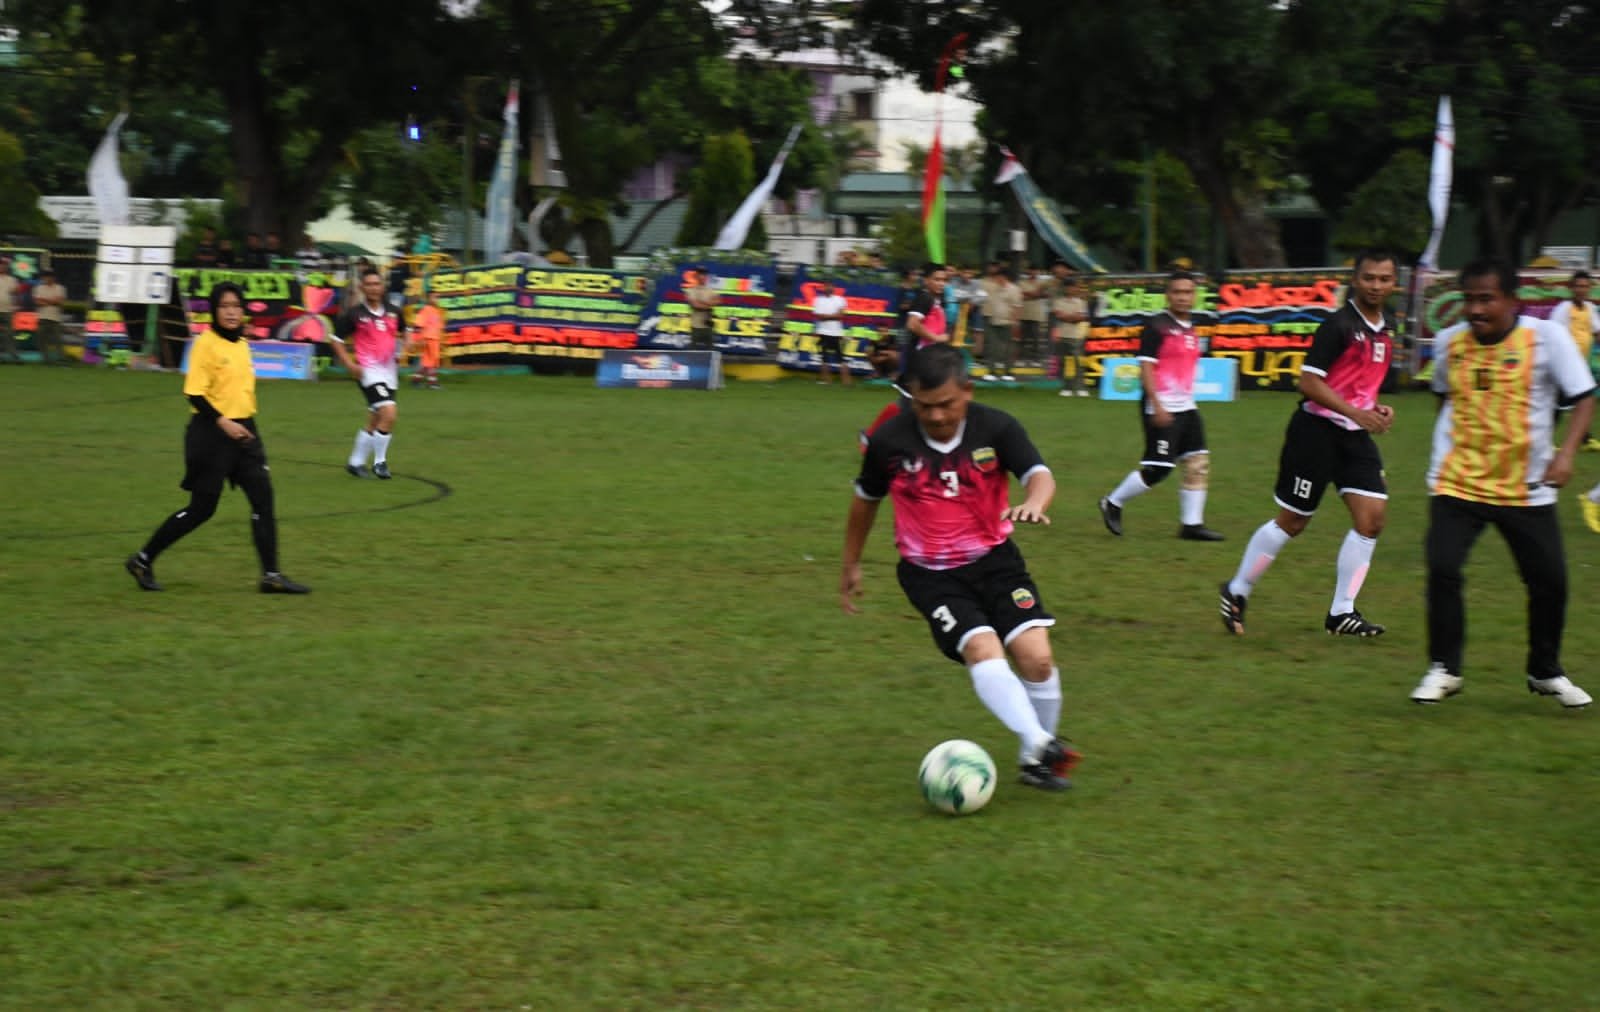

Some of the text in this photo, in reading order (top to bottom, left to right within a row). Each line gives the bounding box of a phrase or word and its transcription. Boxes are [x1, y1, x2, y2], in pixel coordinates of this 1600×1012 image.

[1157, 439, 1169, 455] 2
[940, 471, 959, 497] 3
[1293, 476, 1312, 499] 19
[931, 605, 957, 633] 3
